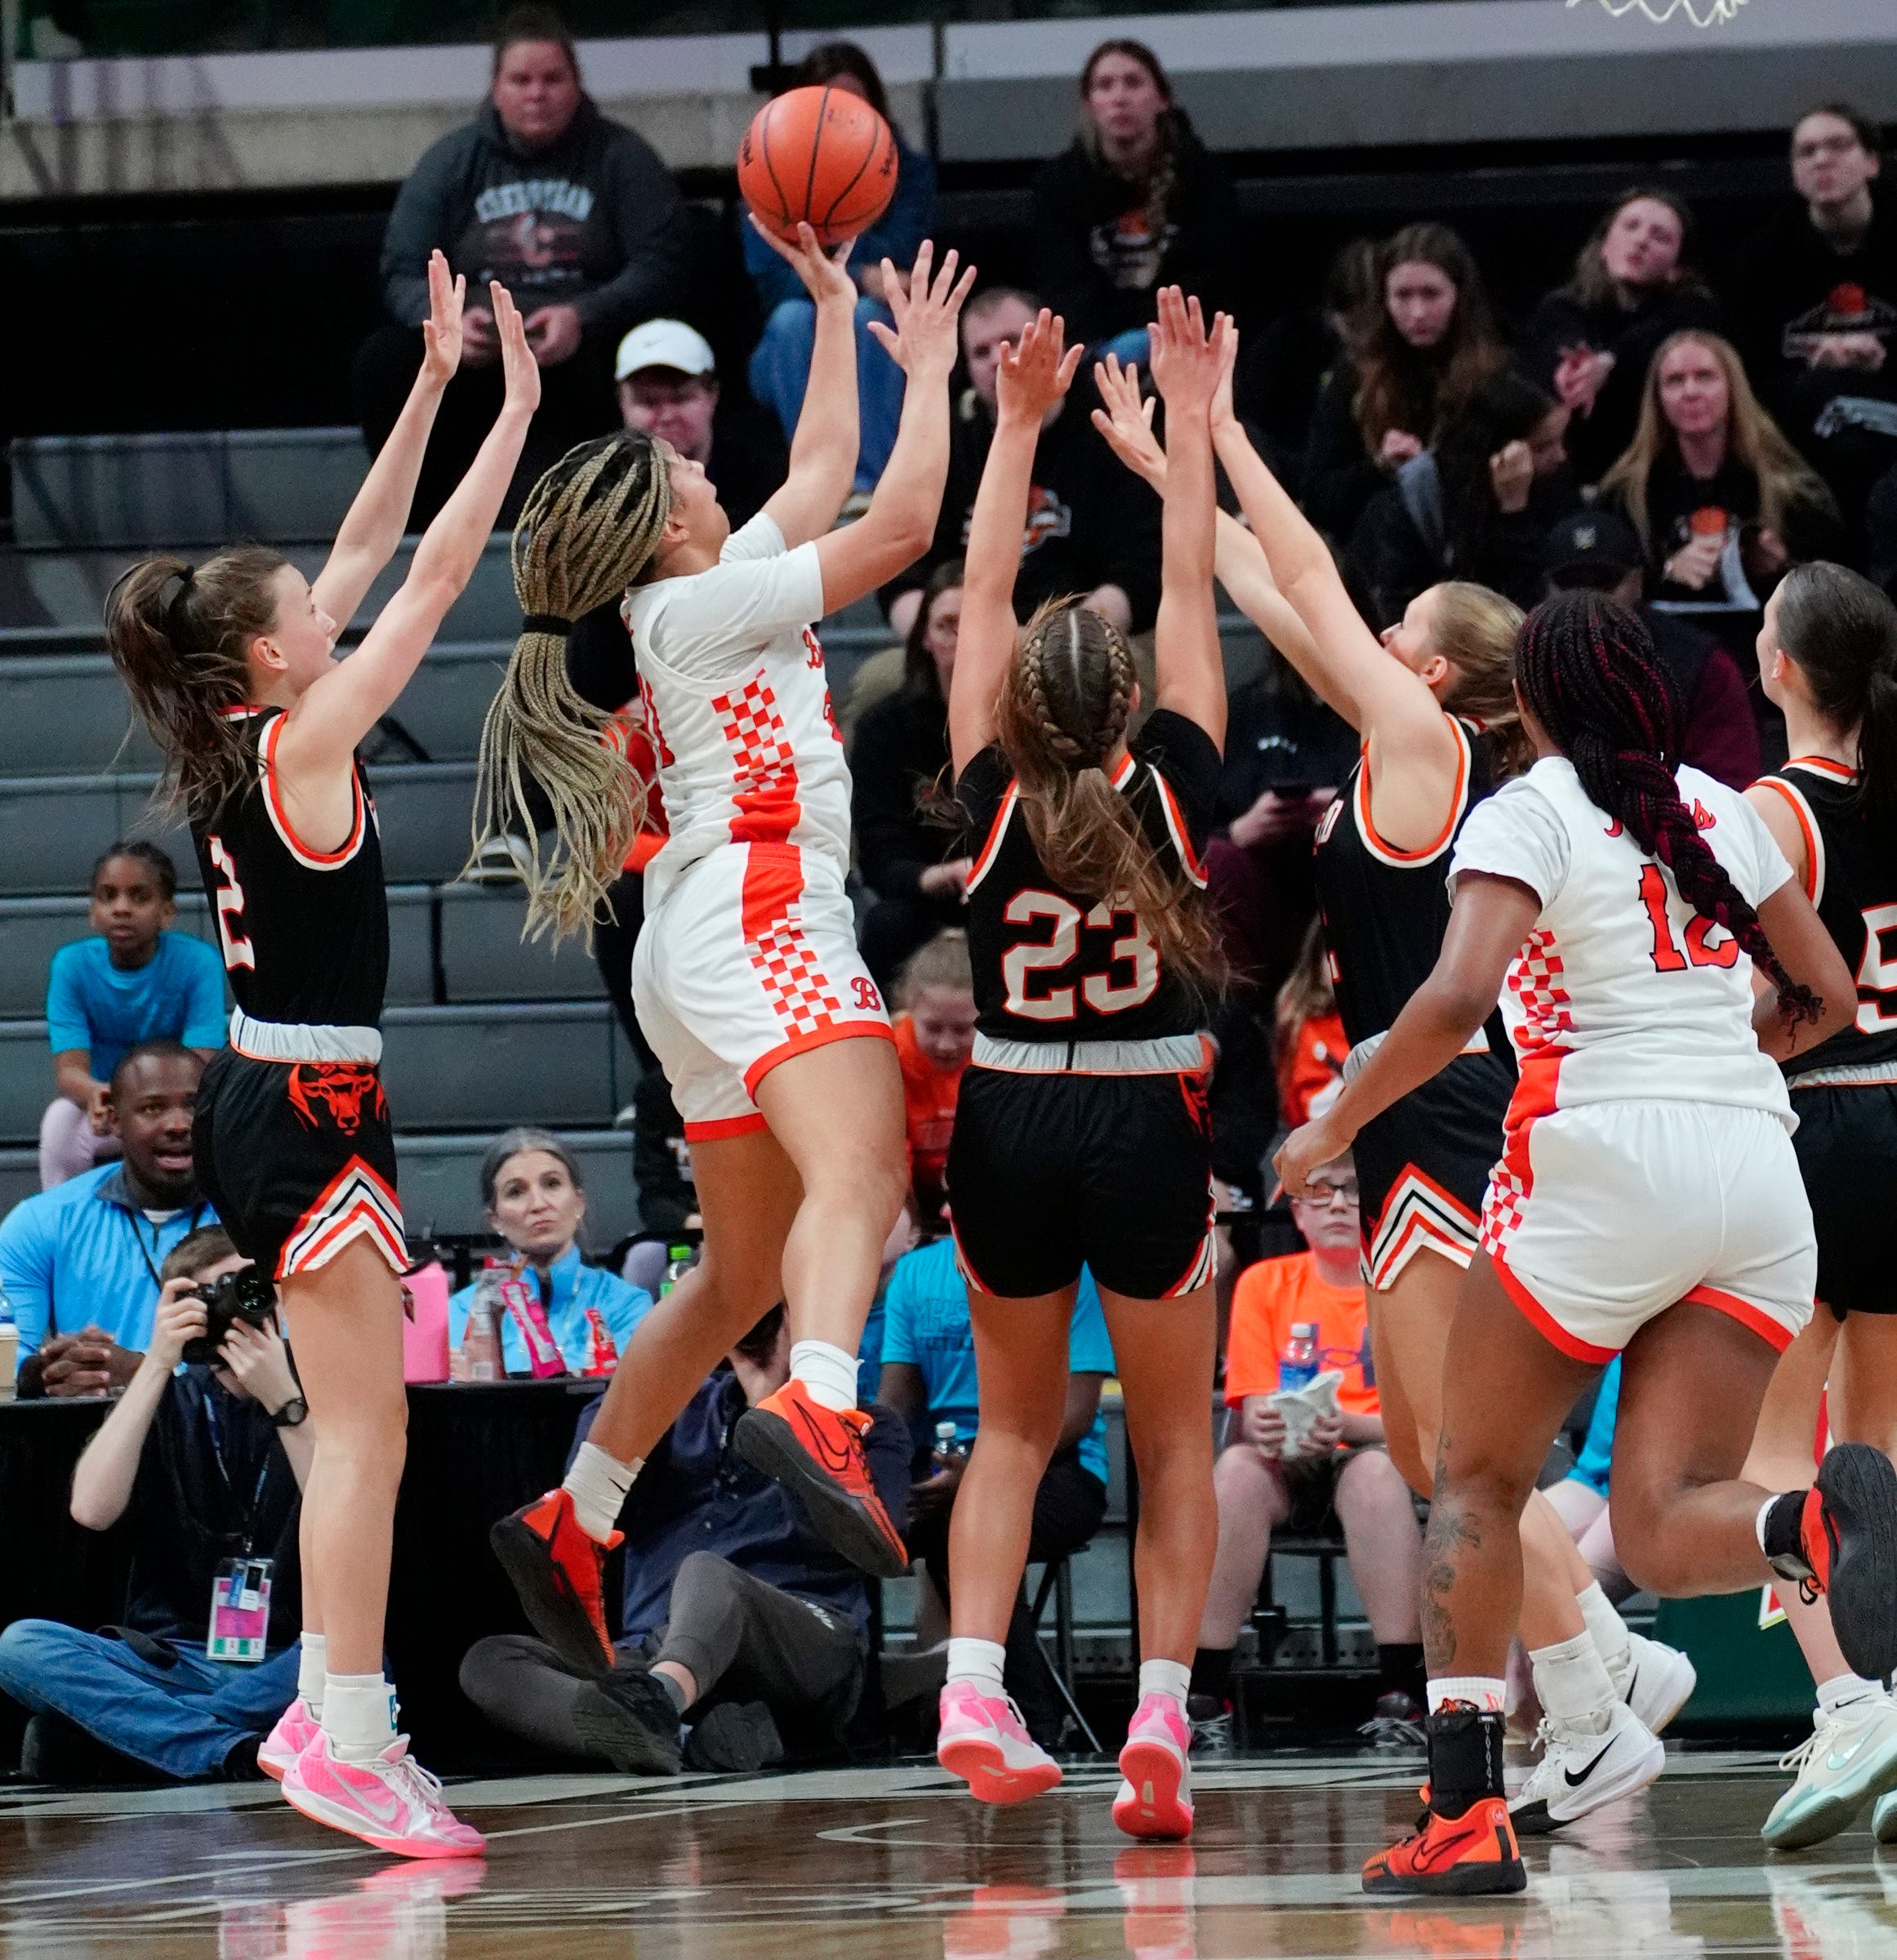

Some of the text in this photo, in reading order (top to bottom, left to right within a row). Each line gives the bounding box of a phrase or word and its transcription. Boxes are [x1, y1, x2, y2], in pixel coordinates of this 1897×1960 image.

[208, 834, 256, 972] 2
[1001, 888, 1162, 1021] 23
[850, 976, 881, 1012] B
